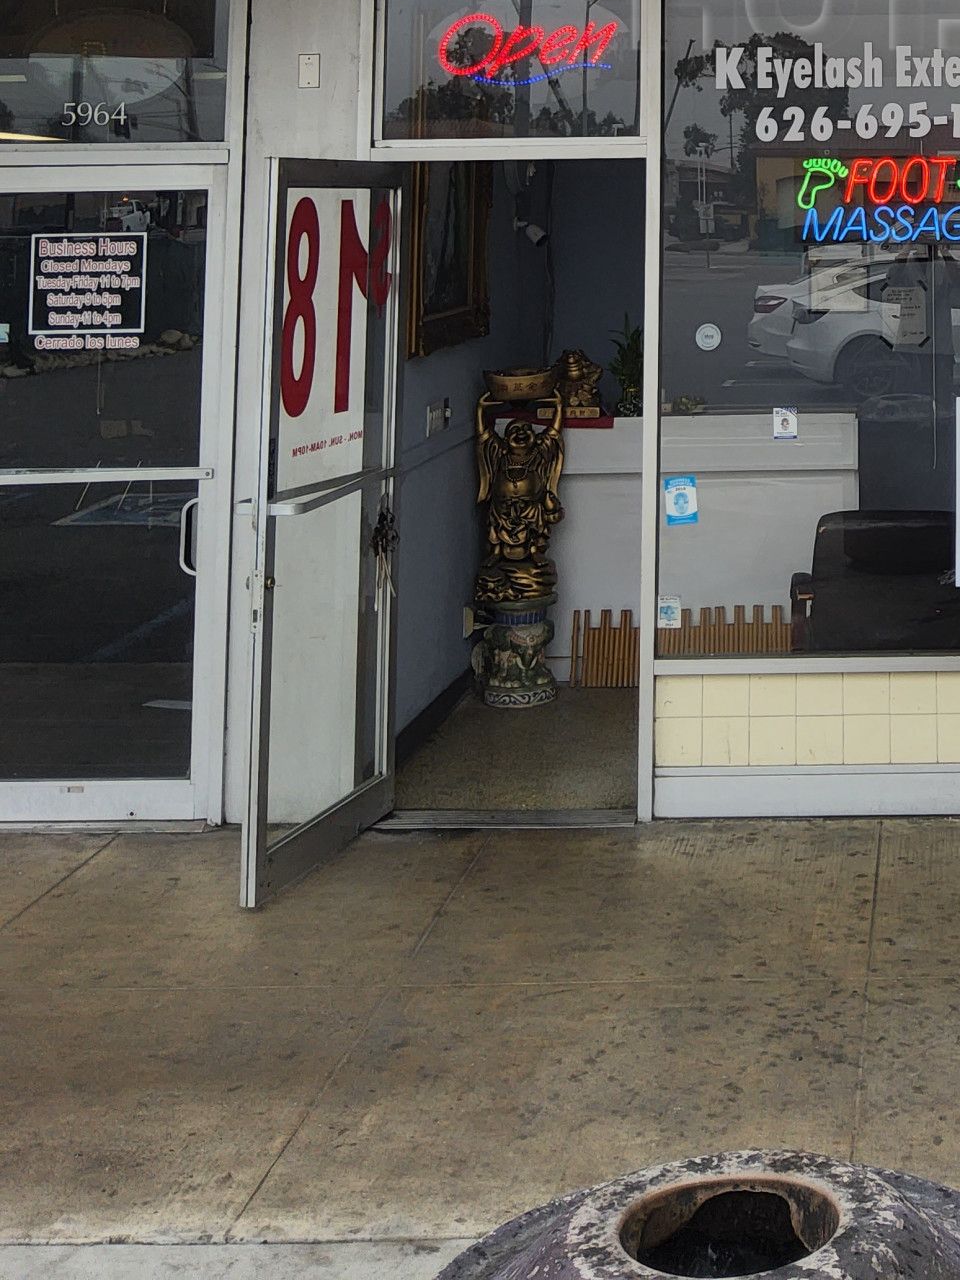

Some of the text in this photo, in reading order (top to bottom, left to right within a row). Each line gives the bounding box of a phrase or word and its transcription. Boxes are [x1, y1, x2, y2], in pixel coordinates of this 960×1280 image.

[437, 13, 618, 79] Open
[715, 47, 747, 90] K
[756, 42, 883, 99] Eyelash
[60, 101, 128, 128] 5964
[843, 156, 957, 206] FOOT
[39, 238, 137, 257] Business Hours
[41, 259, 131, 274] Closed Mondays
[36, 275, 99, 292] Tuesday-Friday
[111, 275, 120, 288] to
[121, 274, 140, 291] 7pm
[92, 293, 102, 306] to
[34, 334, 140, 349] Cerrado los lunes
